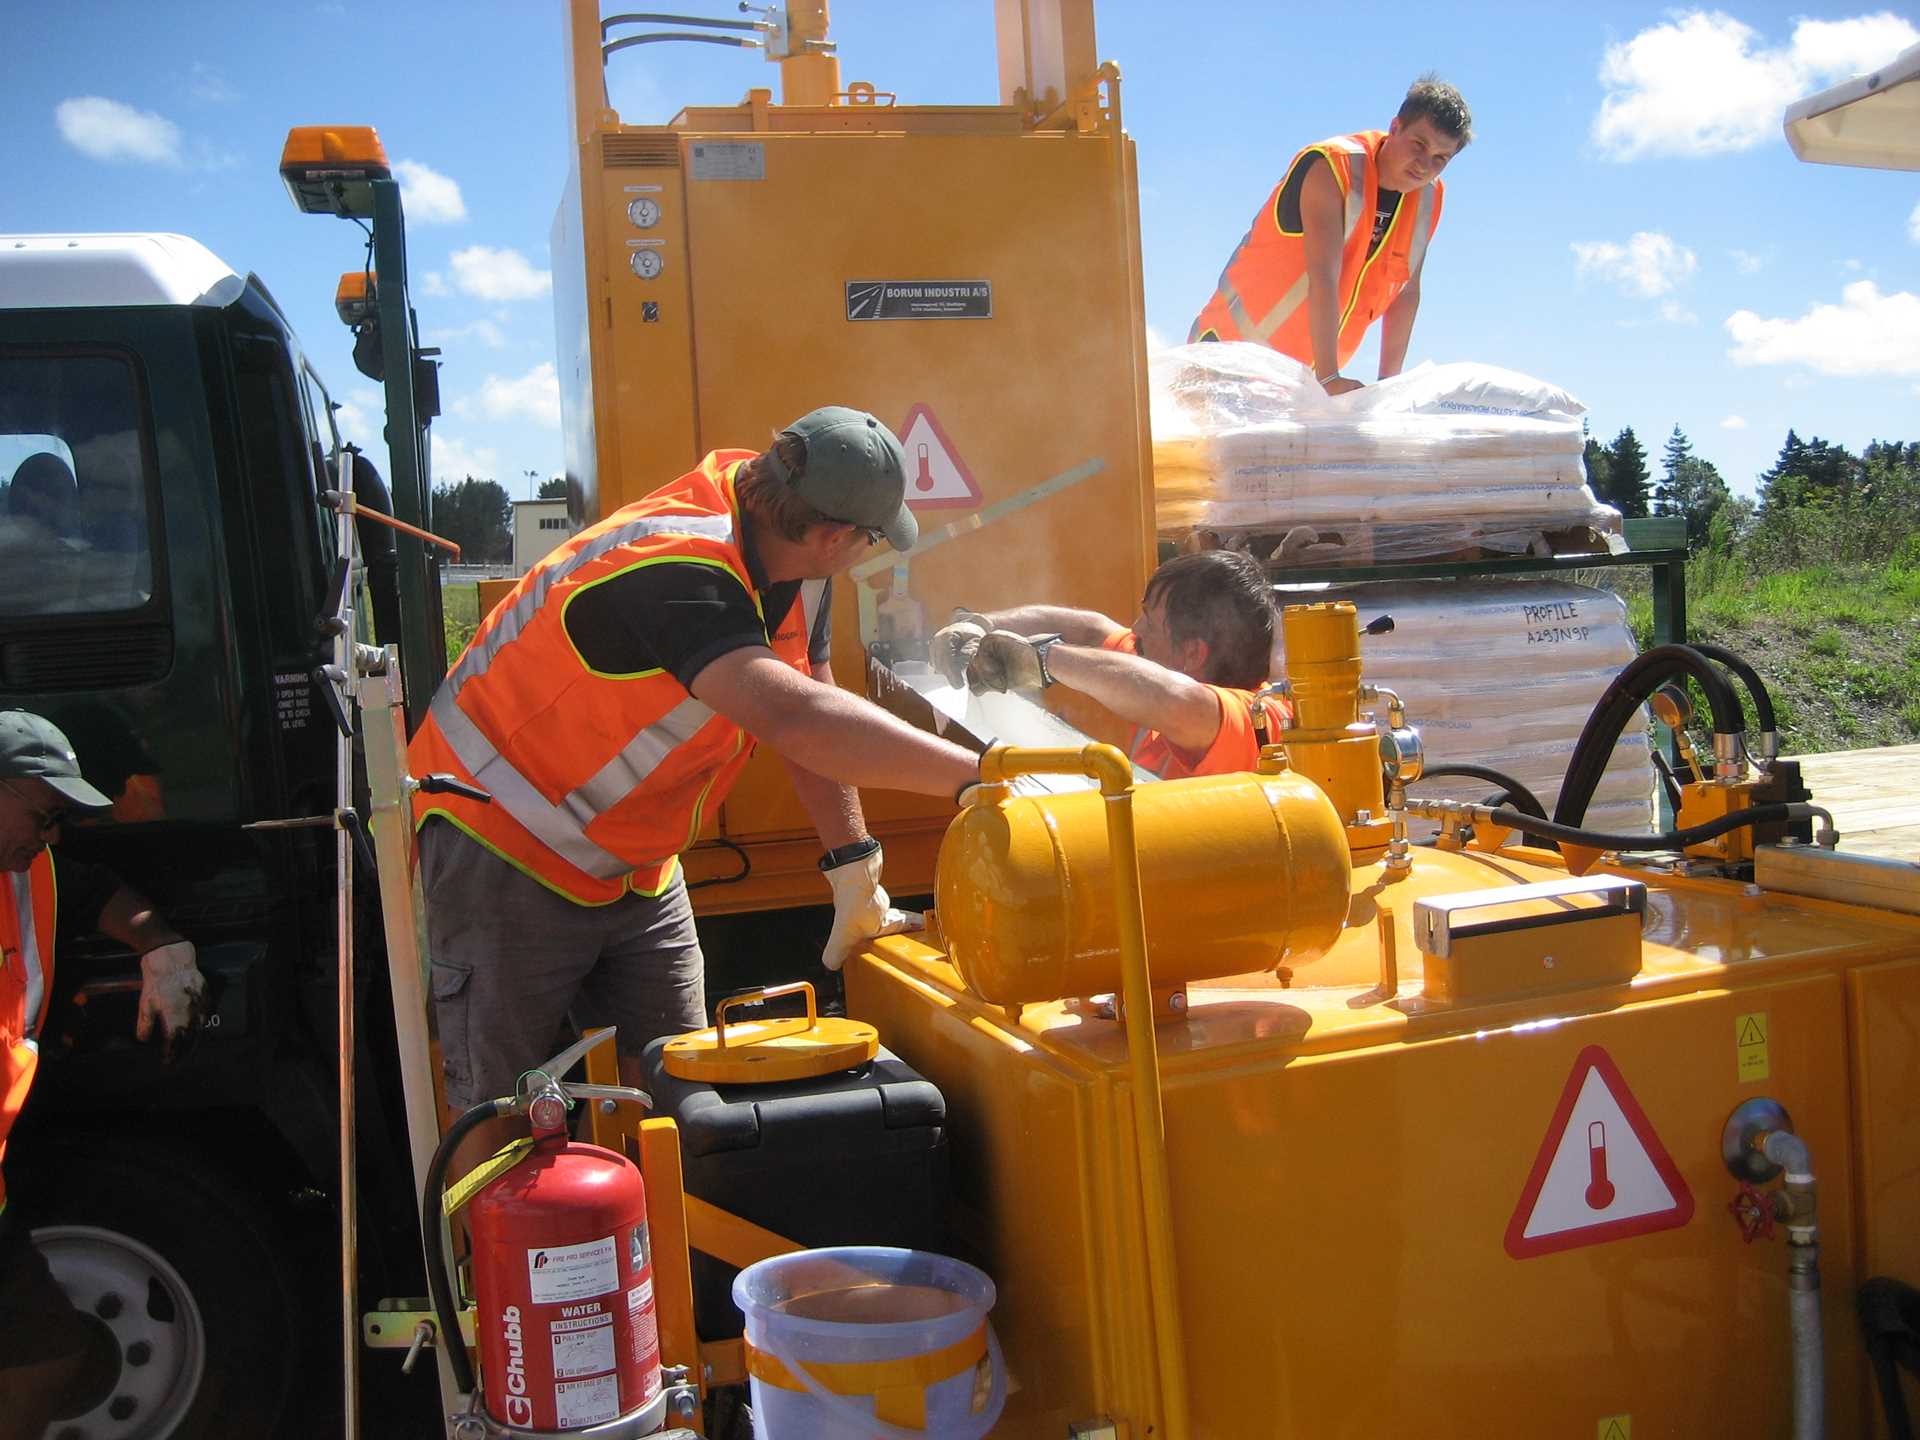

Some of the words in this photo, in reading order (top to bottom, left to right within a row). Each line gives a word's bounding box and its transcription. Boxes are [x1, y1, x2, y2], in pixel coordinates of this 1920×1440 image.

[886, 288, 923, 298] BORUM
[924, 287, 970, 298] INDUSTRI
[972, 287, 988, 297] A/S
[1523, 602, 1578, 624] PROFILE
[552, 1255, 565, 1263] FIRE
[561, 1302, 601, 1318] WATER
[555, 1314, 609, 1330] INSTRUCTIONS
[502, 1305, 527, 1395] Chubb
